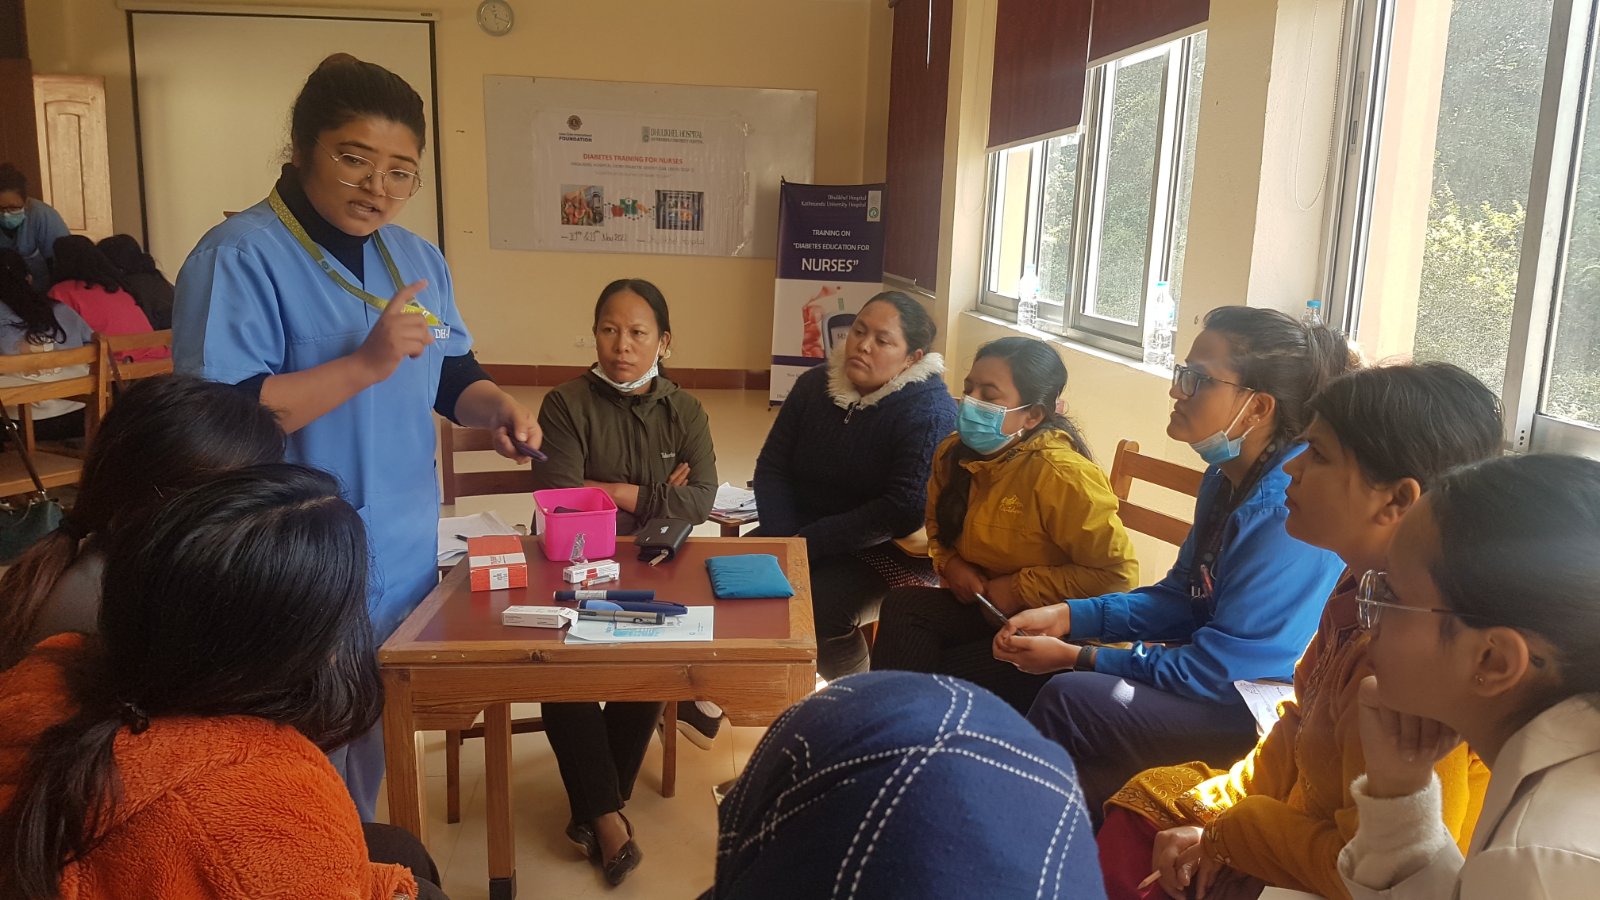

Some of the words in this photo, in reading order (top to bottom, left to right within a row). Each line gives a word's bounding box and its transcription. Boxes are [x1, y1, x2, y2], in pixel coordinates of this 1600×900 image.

[583, 153, 613, 161] DIABETES
[613, 155, 644, 163] TRAINING
[644, 156, 659, 164] FOR
[659, 157, 683, 165] NURSES
[849, 194, 867, 202] Hospital
[812, 229, 840, 237] TRAINING
[822, 243, 857, 251] EDUCATION
